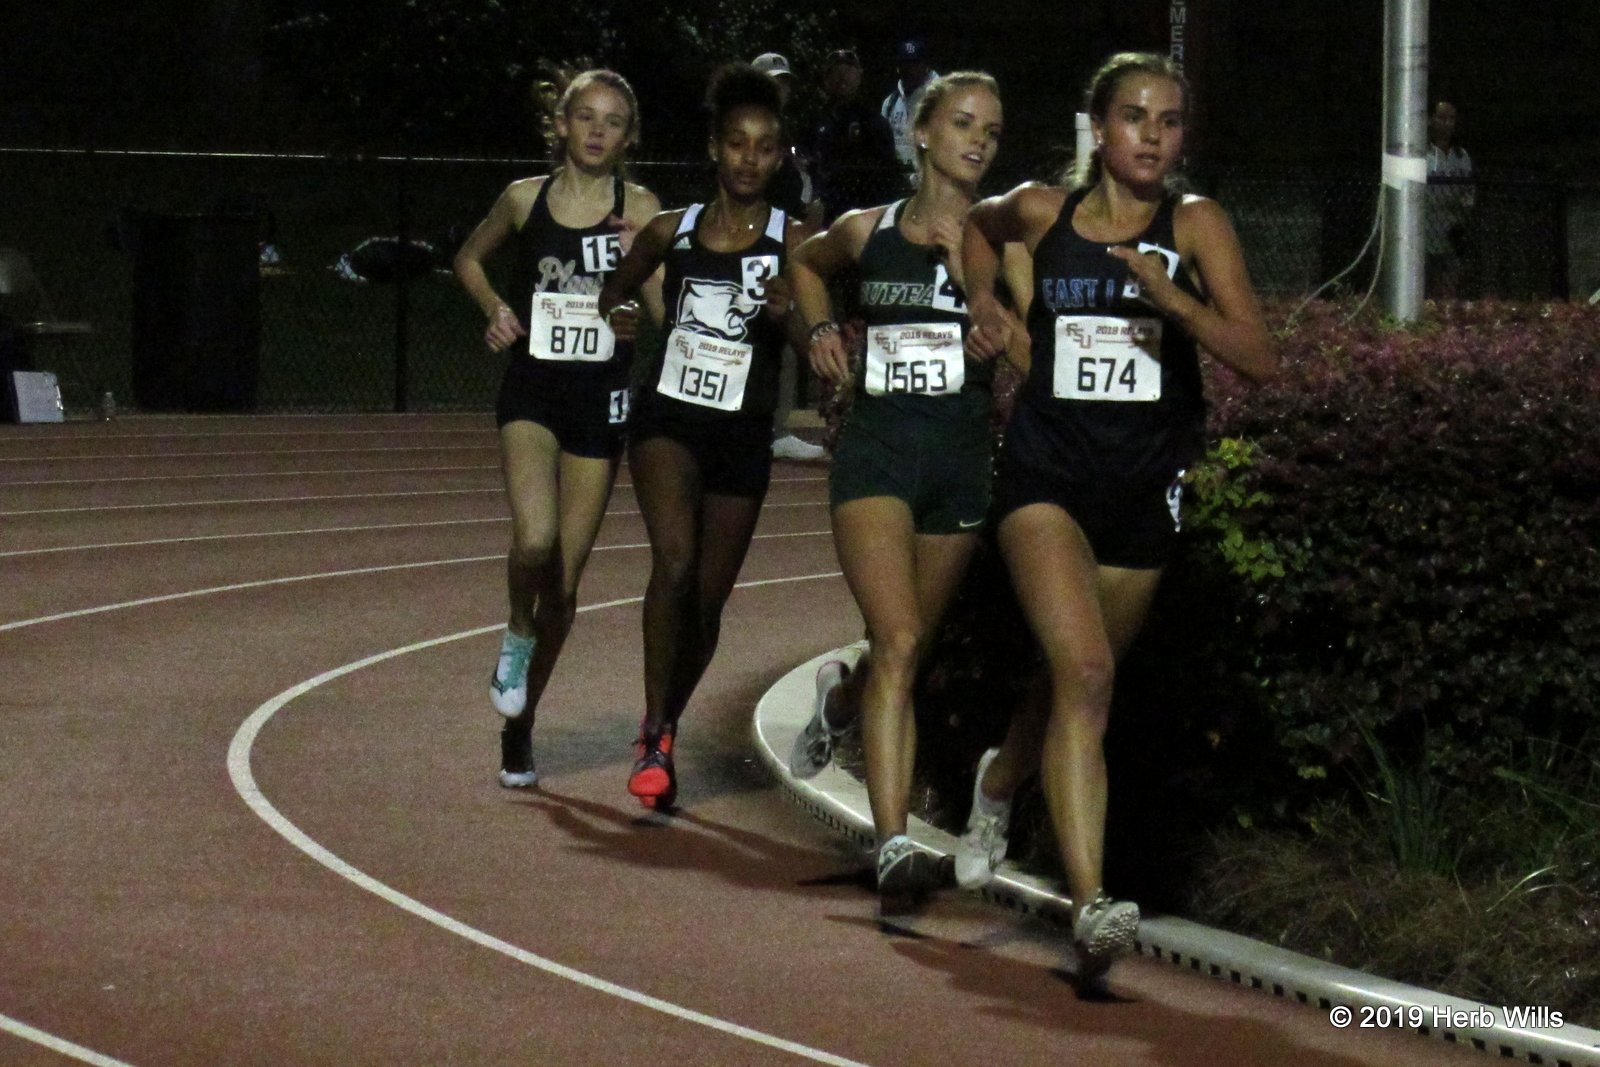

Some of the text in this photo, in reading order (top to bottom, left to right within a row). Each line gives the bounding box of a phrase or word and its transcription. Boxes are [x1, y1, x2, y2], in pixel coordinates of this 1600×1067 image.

[586, 236, 621, 270] 15
[746, 259, 771, 301] 3
[1042, 278, 1098, 308] EAST
[550, 325, 599, 355] 870
[718, 346, 746, 359] RELAYS
[678, 365, 728, 402] 1351
[885, 359, 947, 393] 1563
[1077, 357, 1137, 393] 674
